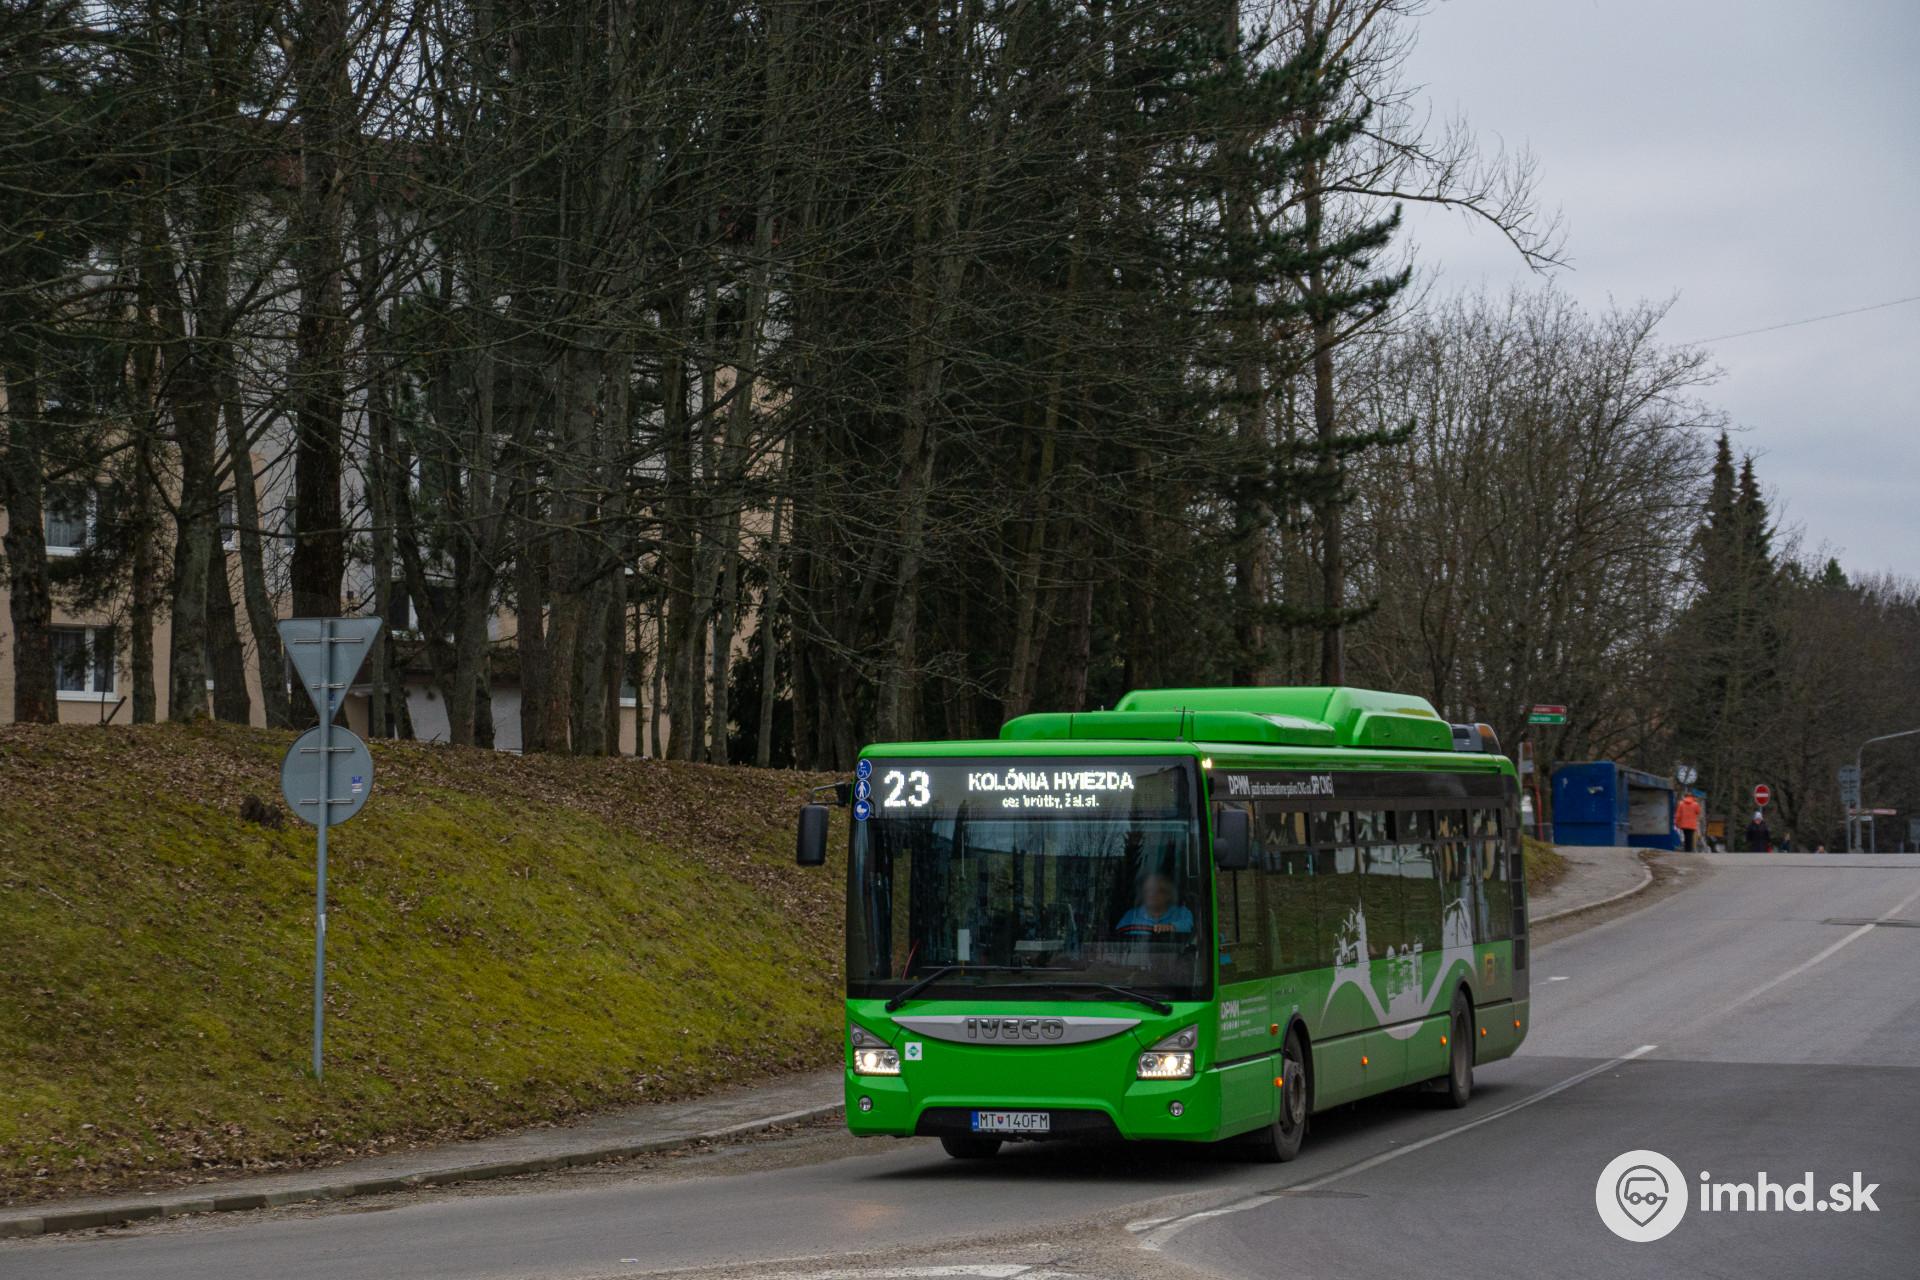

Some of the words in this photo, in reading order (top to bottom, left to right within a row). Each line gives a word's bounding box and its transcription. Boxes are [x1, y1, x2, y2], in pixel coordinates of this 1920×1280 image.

[884, 770, 931, 807] 23
[968, 768, 1049, 791] KOLÓNIA
[1054, 771, 1135, 791] HVIEZDA
[967, 1017, 1064, 1040] IVECO
[980, 1113, 996, 1128] MT
[1006, 1113, 1048, 1129] 140FM
